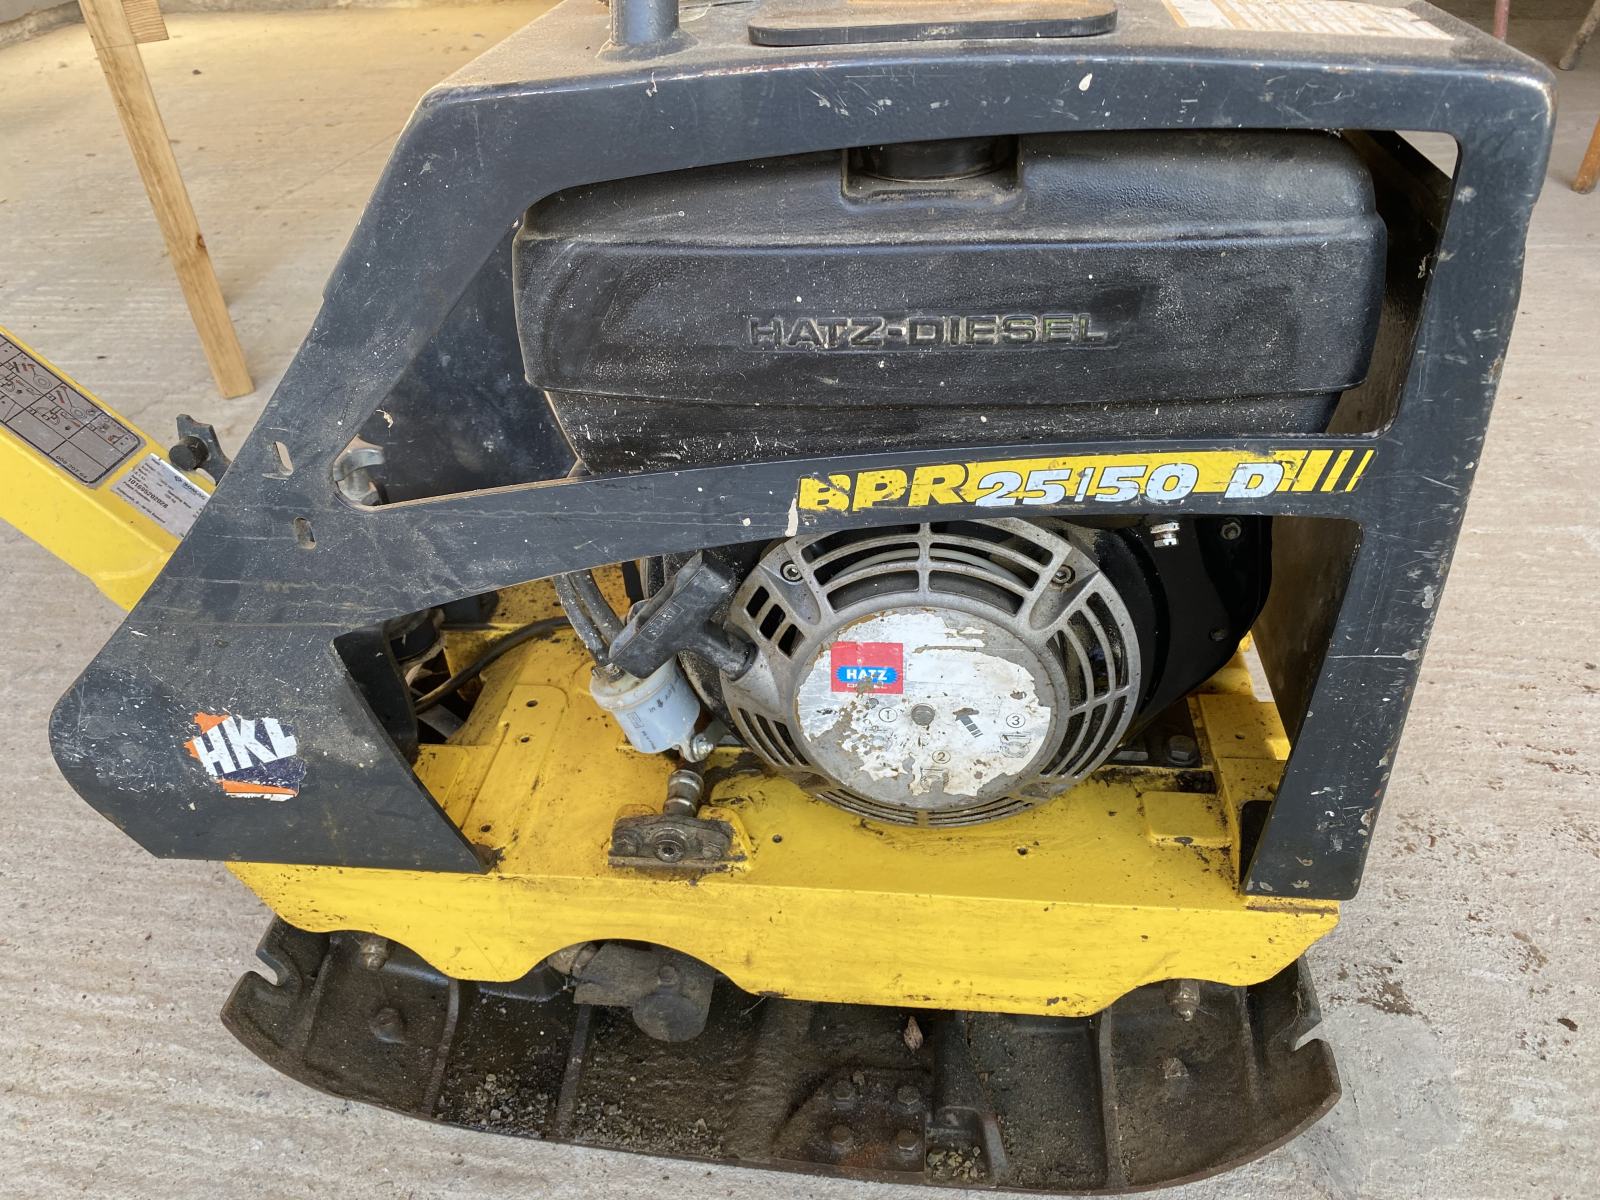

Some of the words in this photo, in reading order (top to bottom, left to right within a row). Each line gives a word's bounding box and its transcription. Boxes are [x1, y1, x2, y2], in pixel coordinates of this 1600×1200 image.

[748, 312, 1108, 348] HATZ-DIESEL
[797, 463, 970, 513] BPR
[1223, 461, 1285, 499] D
[846, 669, 887, 680] HATZ
